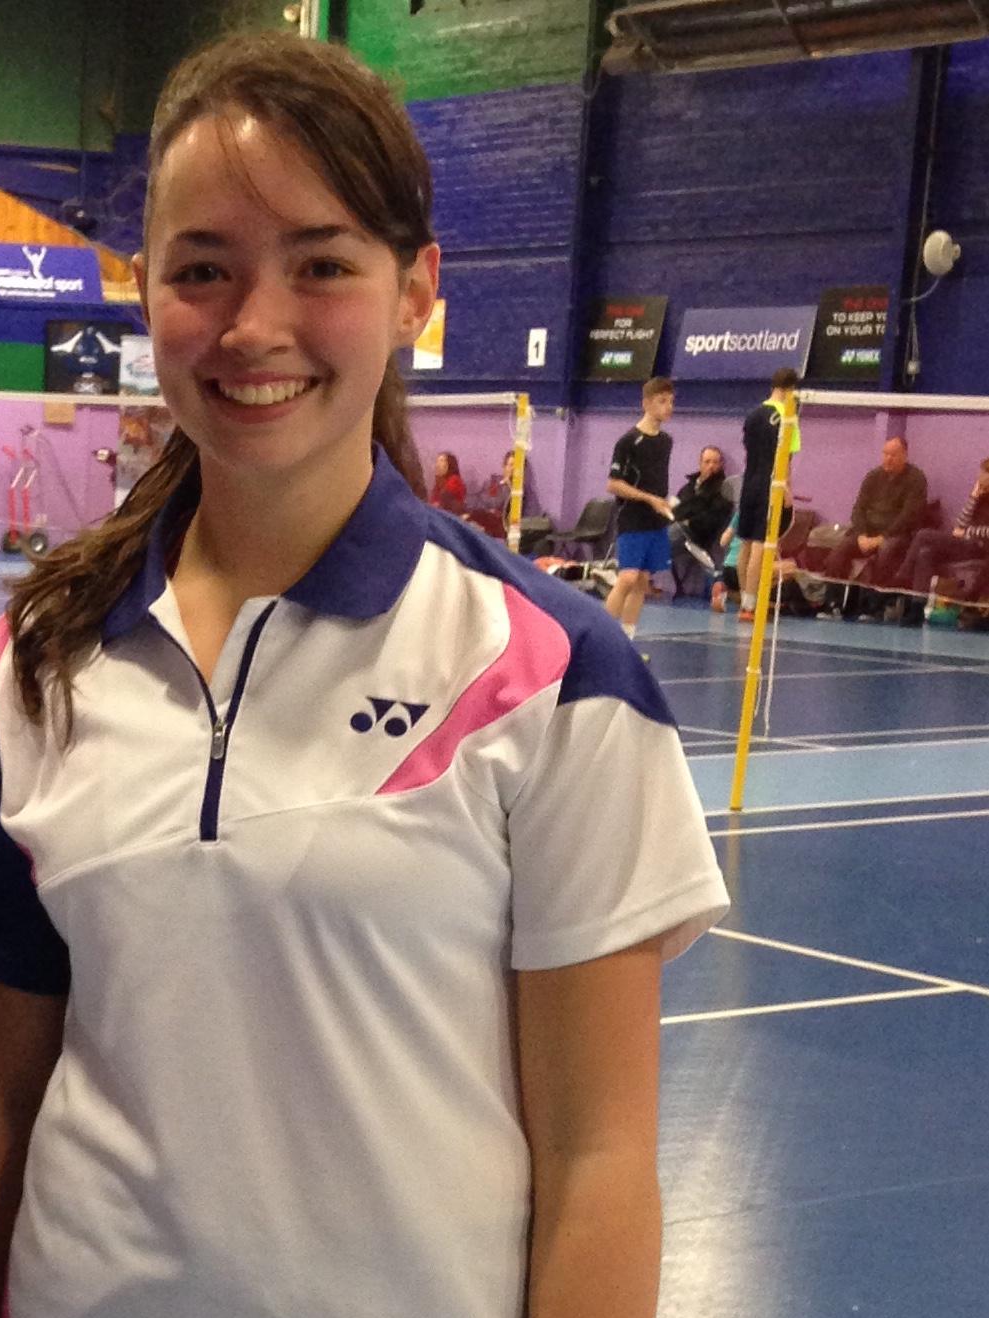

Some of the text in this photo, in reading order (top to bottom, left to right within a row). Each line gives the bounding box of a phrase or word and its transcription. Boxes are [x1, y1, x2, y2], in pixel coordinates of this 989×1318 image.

[613, 317, 634, 328] FOR
[832, 312, 847, 323] TO
[848, 311, 873, 323] KEEP
[826, 325, 841, 336] ON
[843, 324, 873, 337] YOUR
[534, 340, 540, 359] 1
[684, 329, 801, 357] sportscotland
